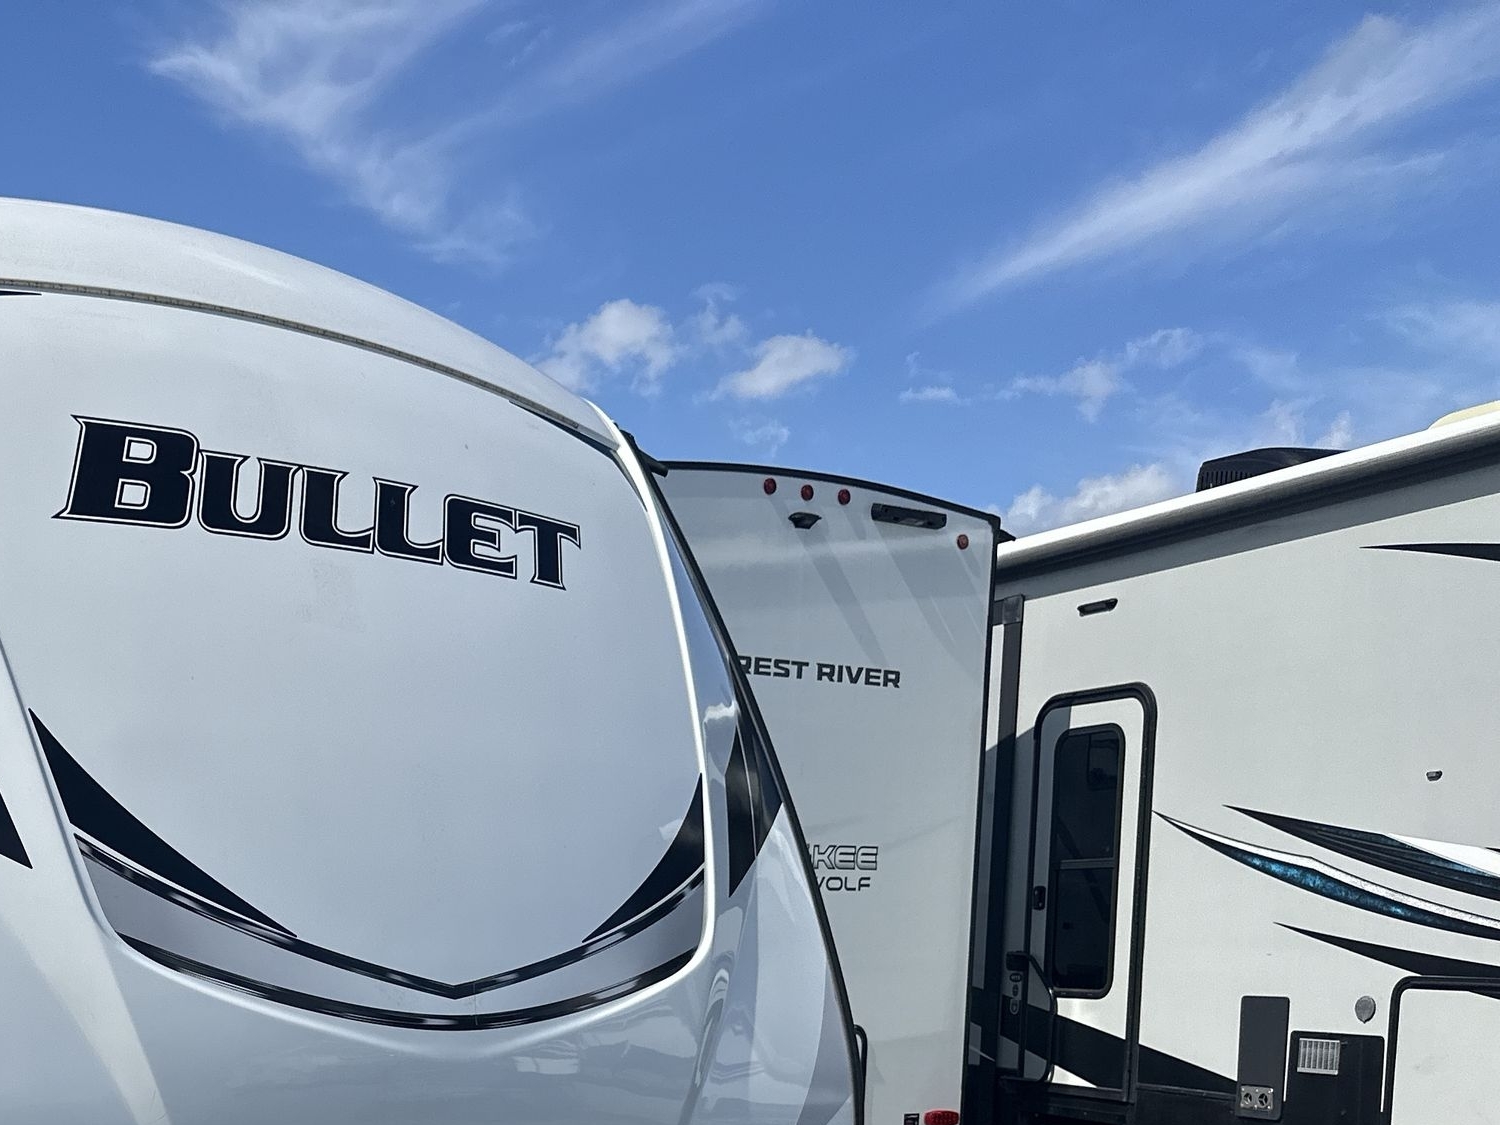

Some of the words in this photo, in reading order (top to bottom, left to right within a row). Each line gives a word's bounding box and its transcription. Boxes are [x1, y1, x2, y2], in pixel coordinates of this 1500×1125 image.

[51, 414, 581, 591] BULLET
[737, 655, 809, 679] REST
[816, 663, 901, 688] RIVER
[807, 843, 878, 871] KEE
